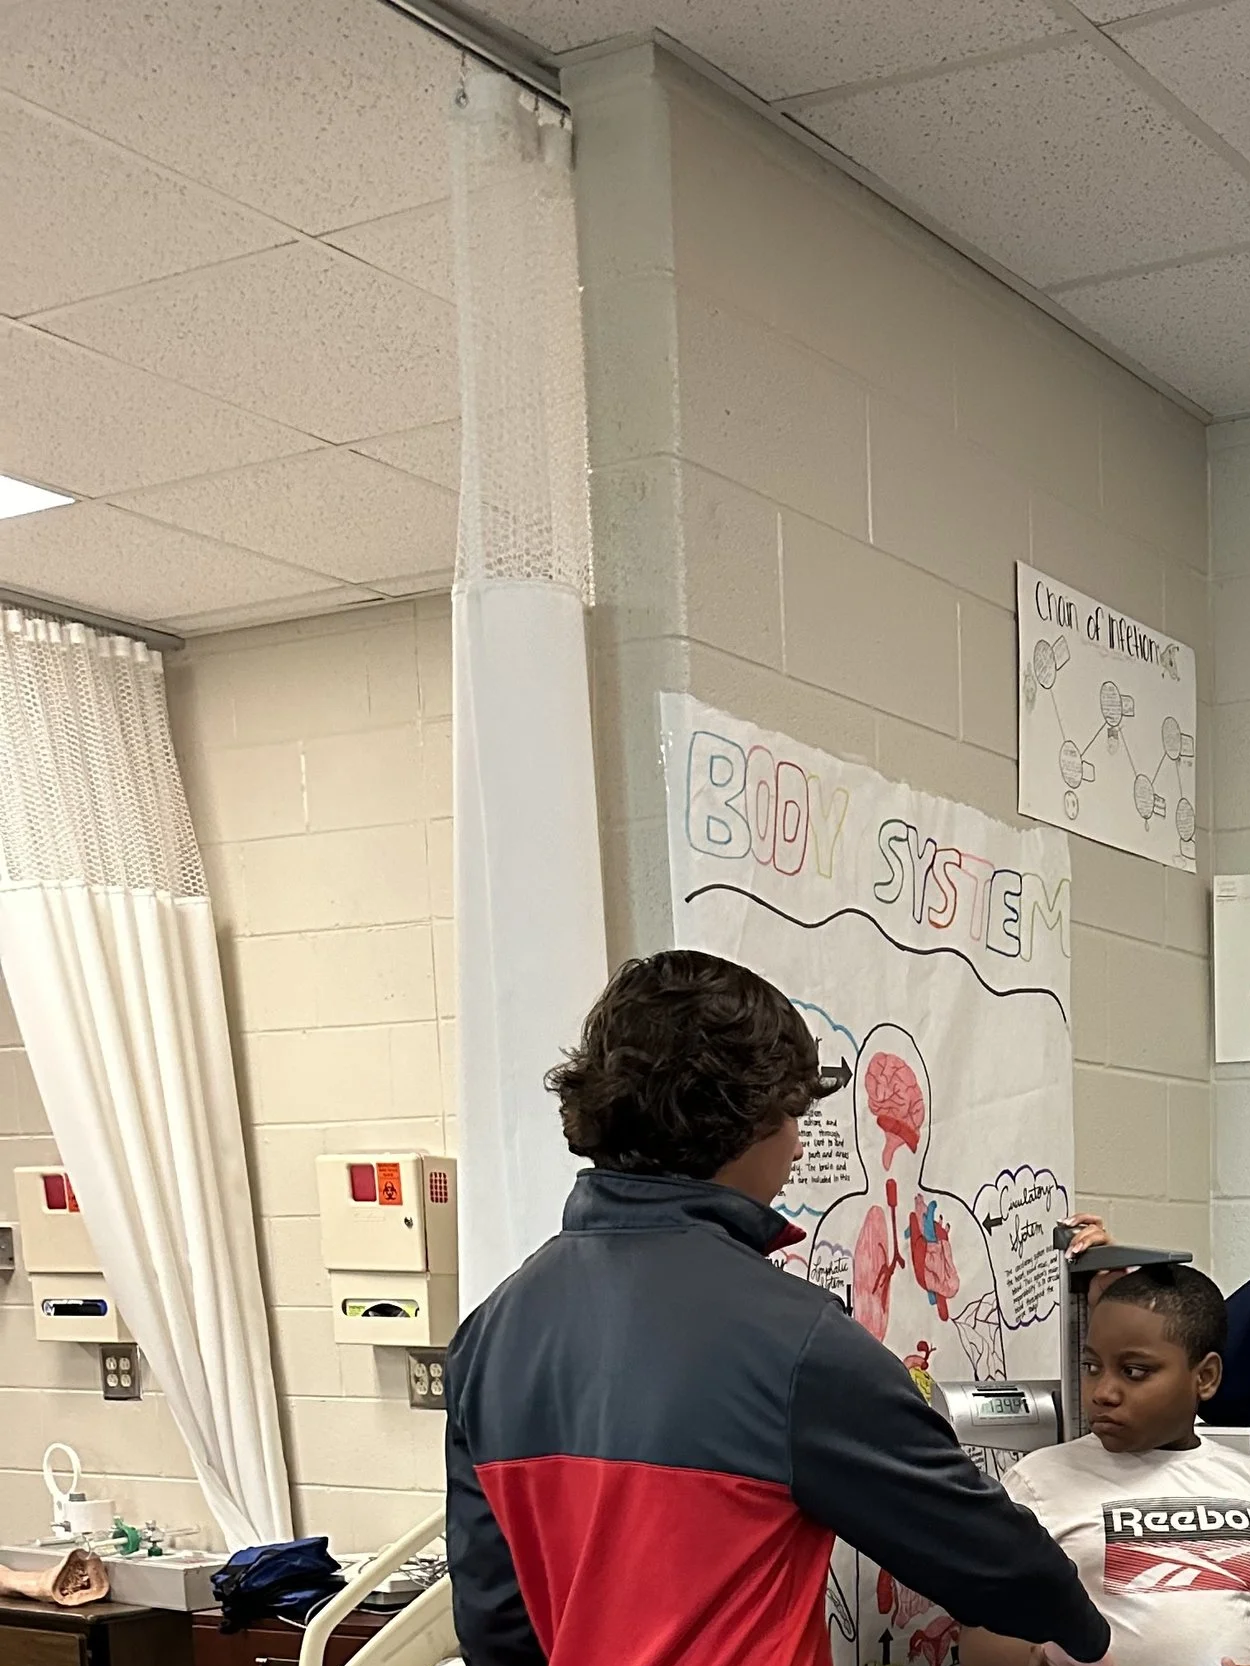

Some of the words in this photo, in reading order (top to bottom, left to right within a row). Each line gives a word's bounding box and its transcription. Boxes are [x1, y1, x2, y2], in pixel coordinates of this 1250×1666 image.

[1035, 580, 1079, 633] Chain
[1087, 606, 1104, 641] of
[686, 731, 850, 879] BODY
[873, 819, 1071, 962] SYSTEM
[999, 1183, 1055, 1221] Circulatory
[811, 1256, 849, 1283] Lymphatic
